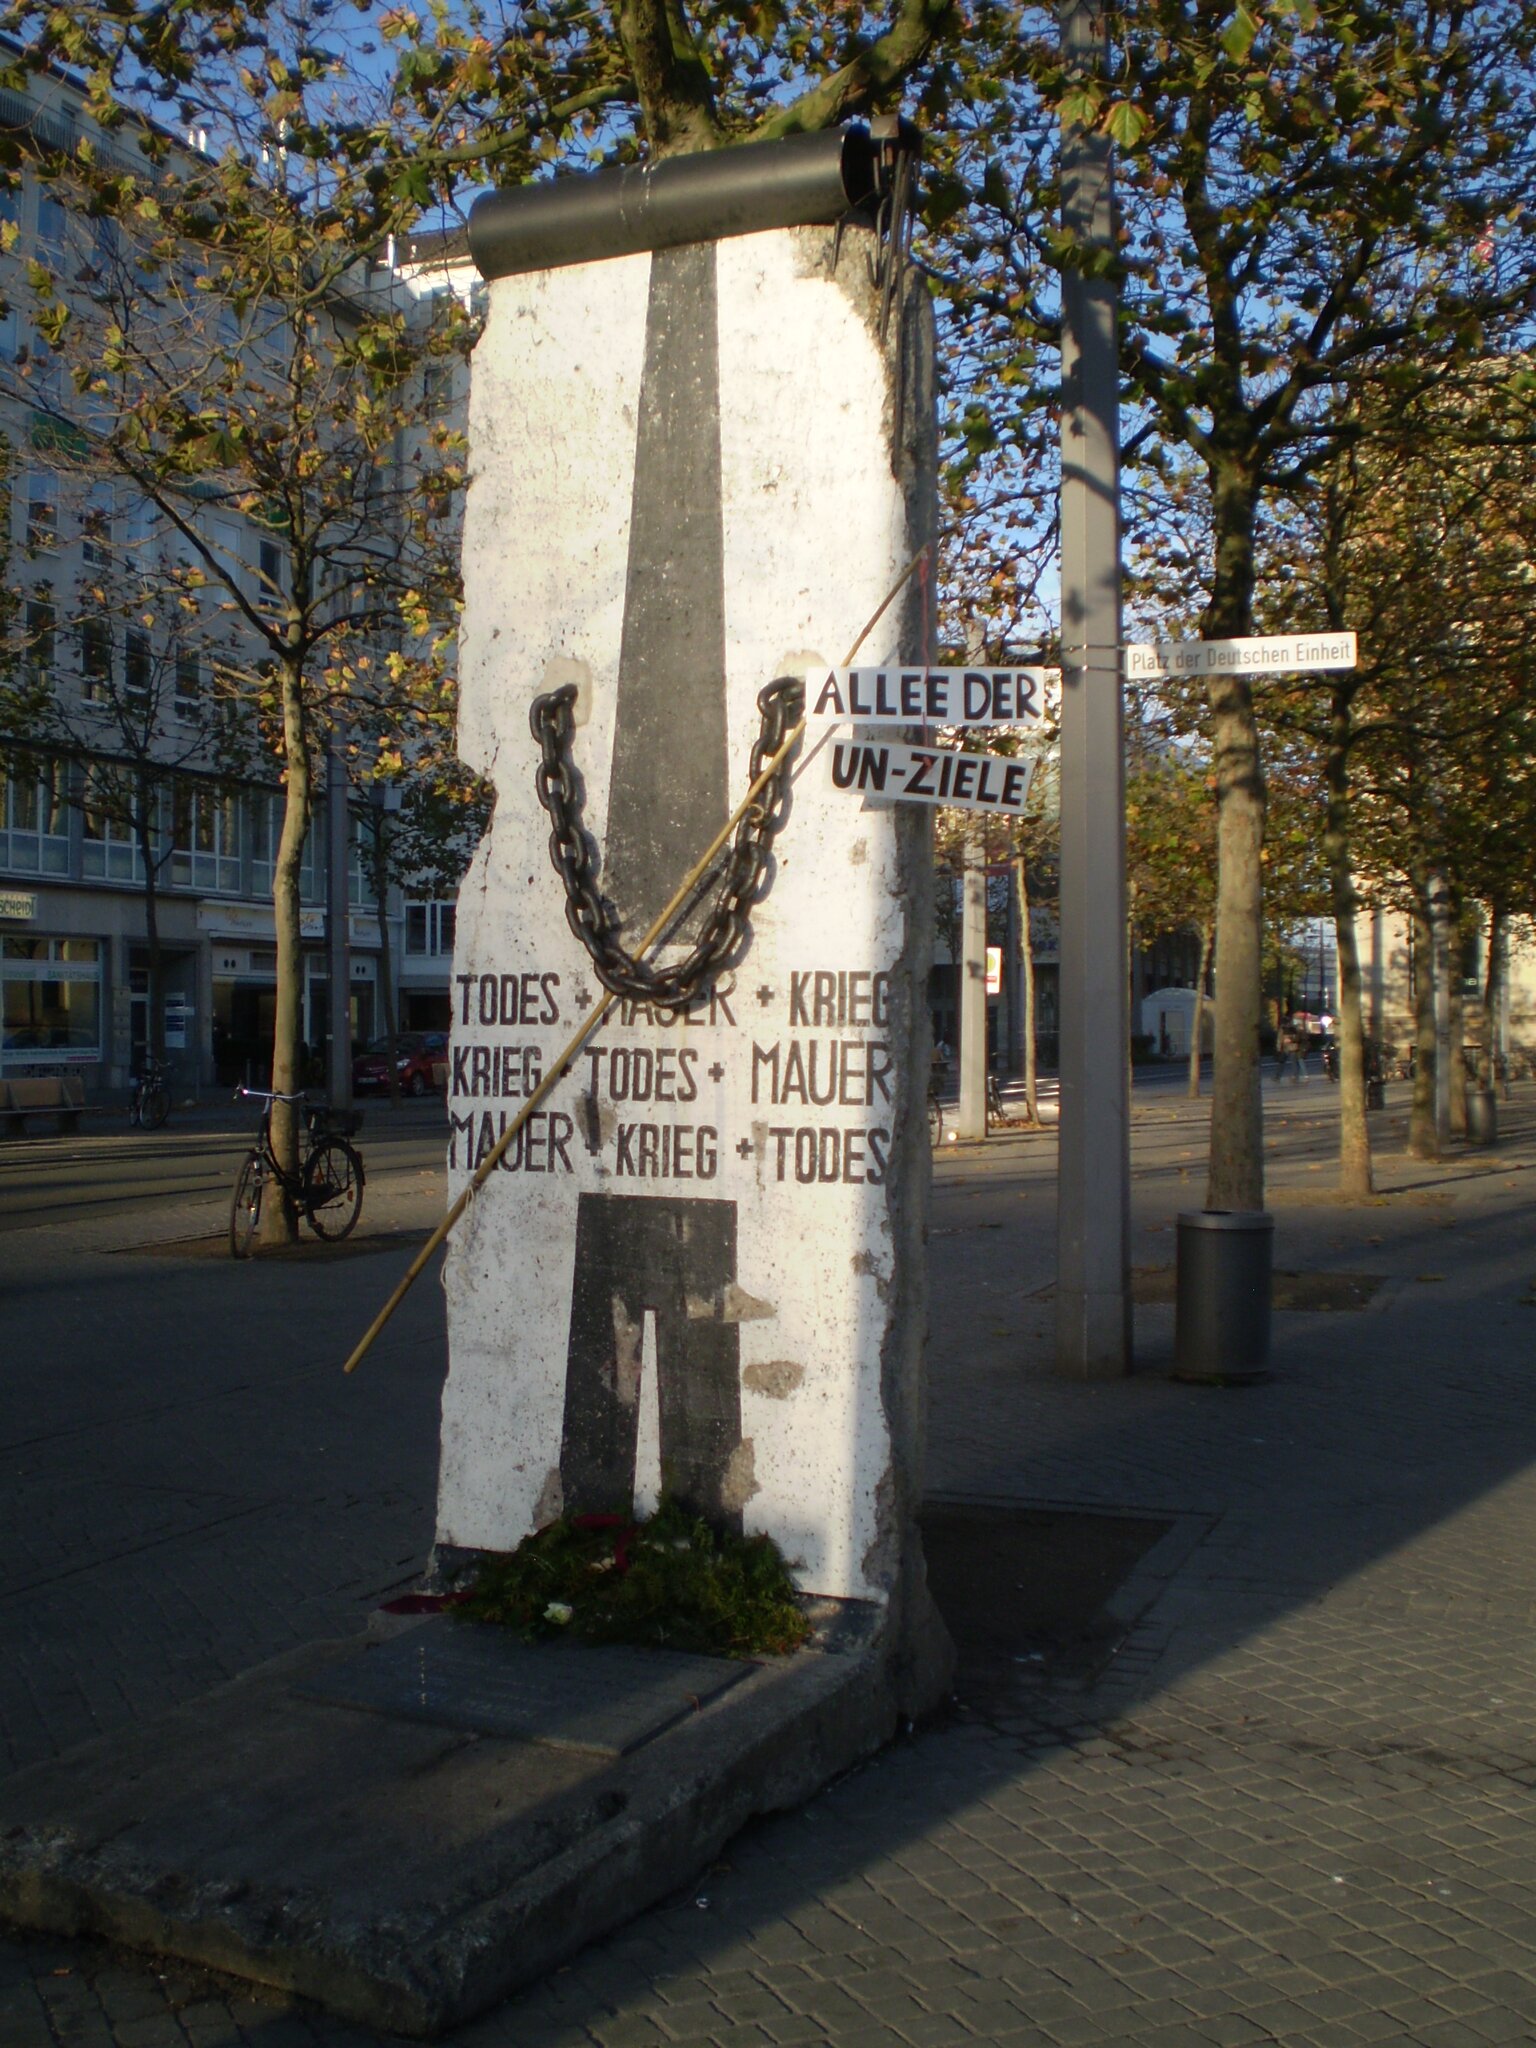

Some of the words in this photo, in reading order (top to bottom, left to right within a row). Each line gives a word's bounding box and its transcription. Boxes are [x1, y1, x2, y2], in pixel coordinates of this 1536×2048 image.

[1132, 652, 1169, 671] Platz
[1175, 651, 1201, 669] der
[1207, 645, 1289, 667] Deutschen
[1296, 640, 1350, 662] Einheit
[812, 670, 949, 718] ALLEE
[963, 672, 1042, 721] DER
[831, 743, 1026, 807] UN-ZIELE
[456, 972, 560, 1026] TODES
[789, 970, 889, 1028] KRIEG
[453, 1045, 542, 1098] KRIEG
[584, 1046, 698, 1103] TODES
[751, 1039, 893, 1106] MAUER
[449, 1110, 574, 1174] MAUER
[616, 1123, 718, 1180] KRIEG
[768, 1127, 890, 1186] TODES
